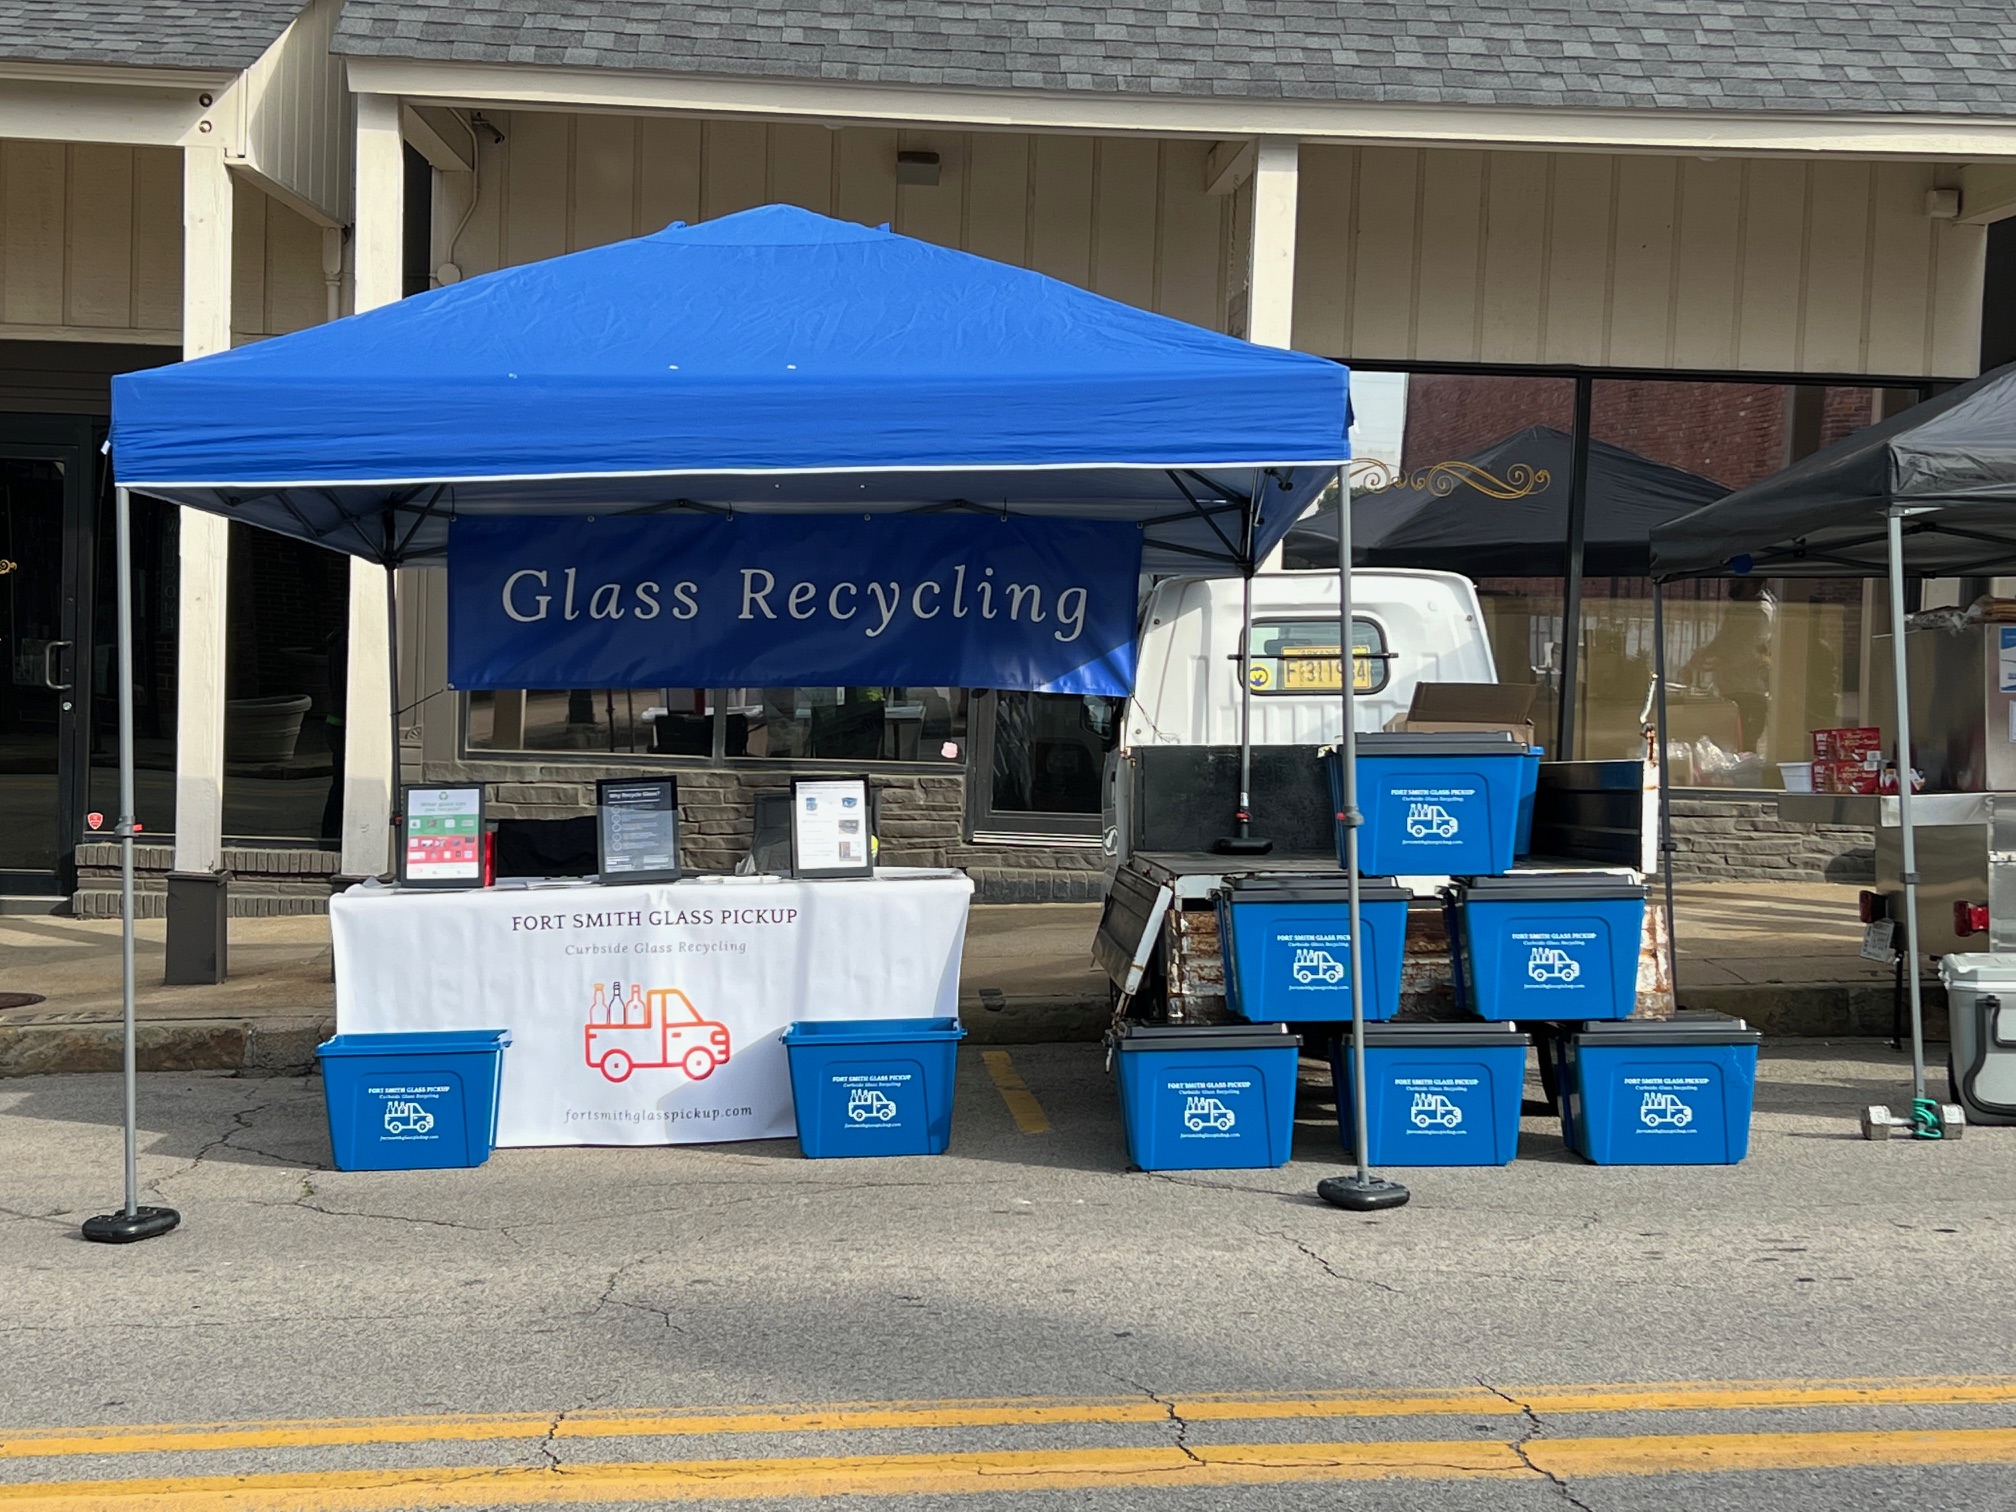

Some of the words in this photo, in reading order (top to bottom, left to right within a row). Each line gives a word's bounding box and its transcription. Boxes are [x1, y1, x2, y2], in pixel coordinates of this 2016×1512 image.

[501, 566, 699, 623] Glass
[738, 564, 1088, 643] Recycling
[511, 915, 566, 931] FORT
[573, 911, 642, 929] SMITH
[649, 910, 714, 926] GLASS
[720, 908, 798, 925] PICKUP
[565, 942, 629, 956] Curbside
[634, 942, 673, 954] Glass
[678, 940, 747, 955] Recycling
[564, 1106, 753, 1124] fortsmithglasspickup.com
